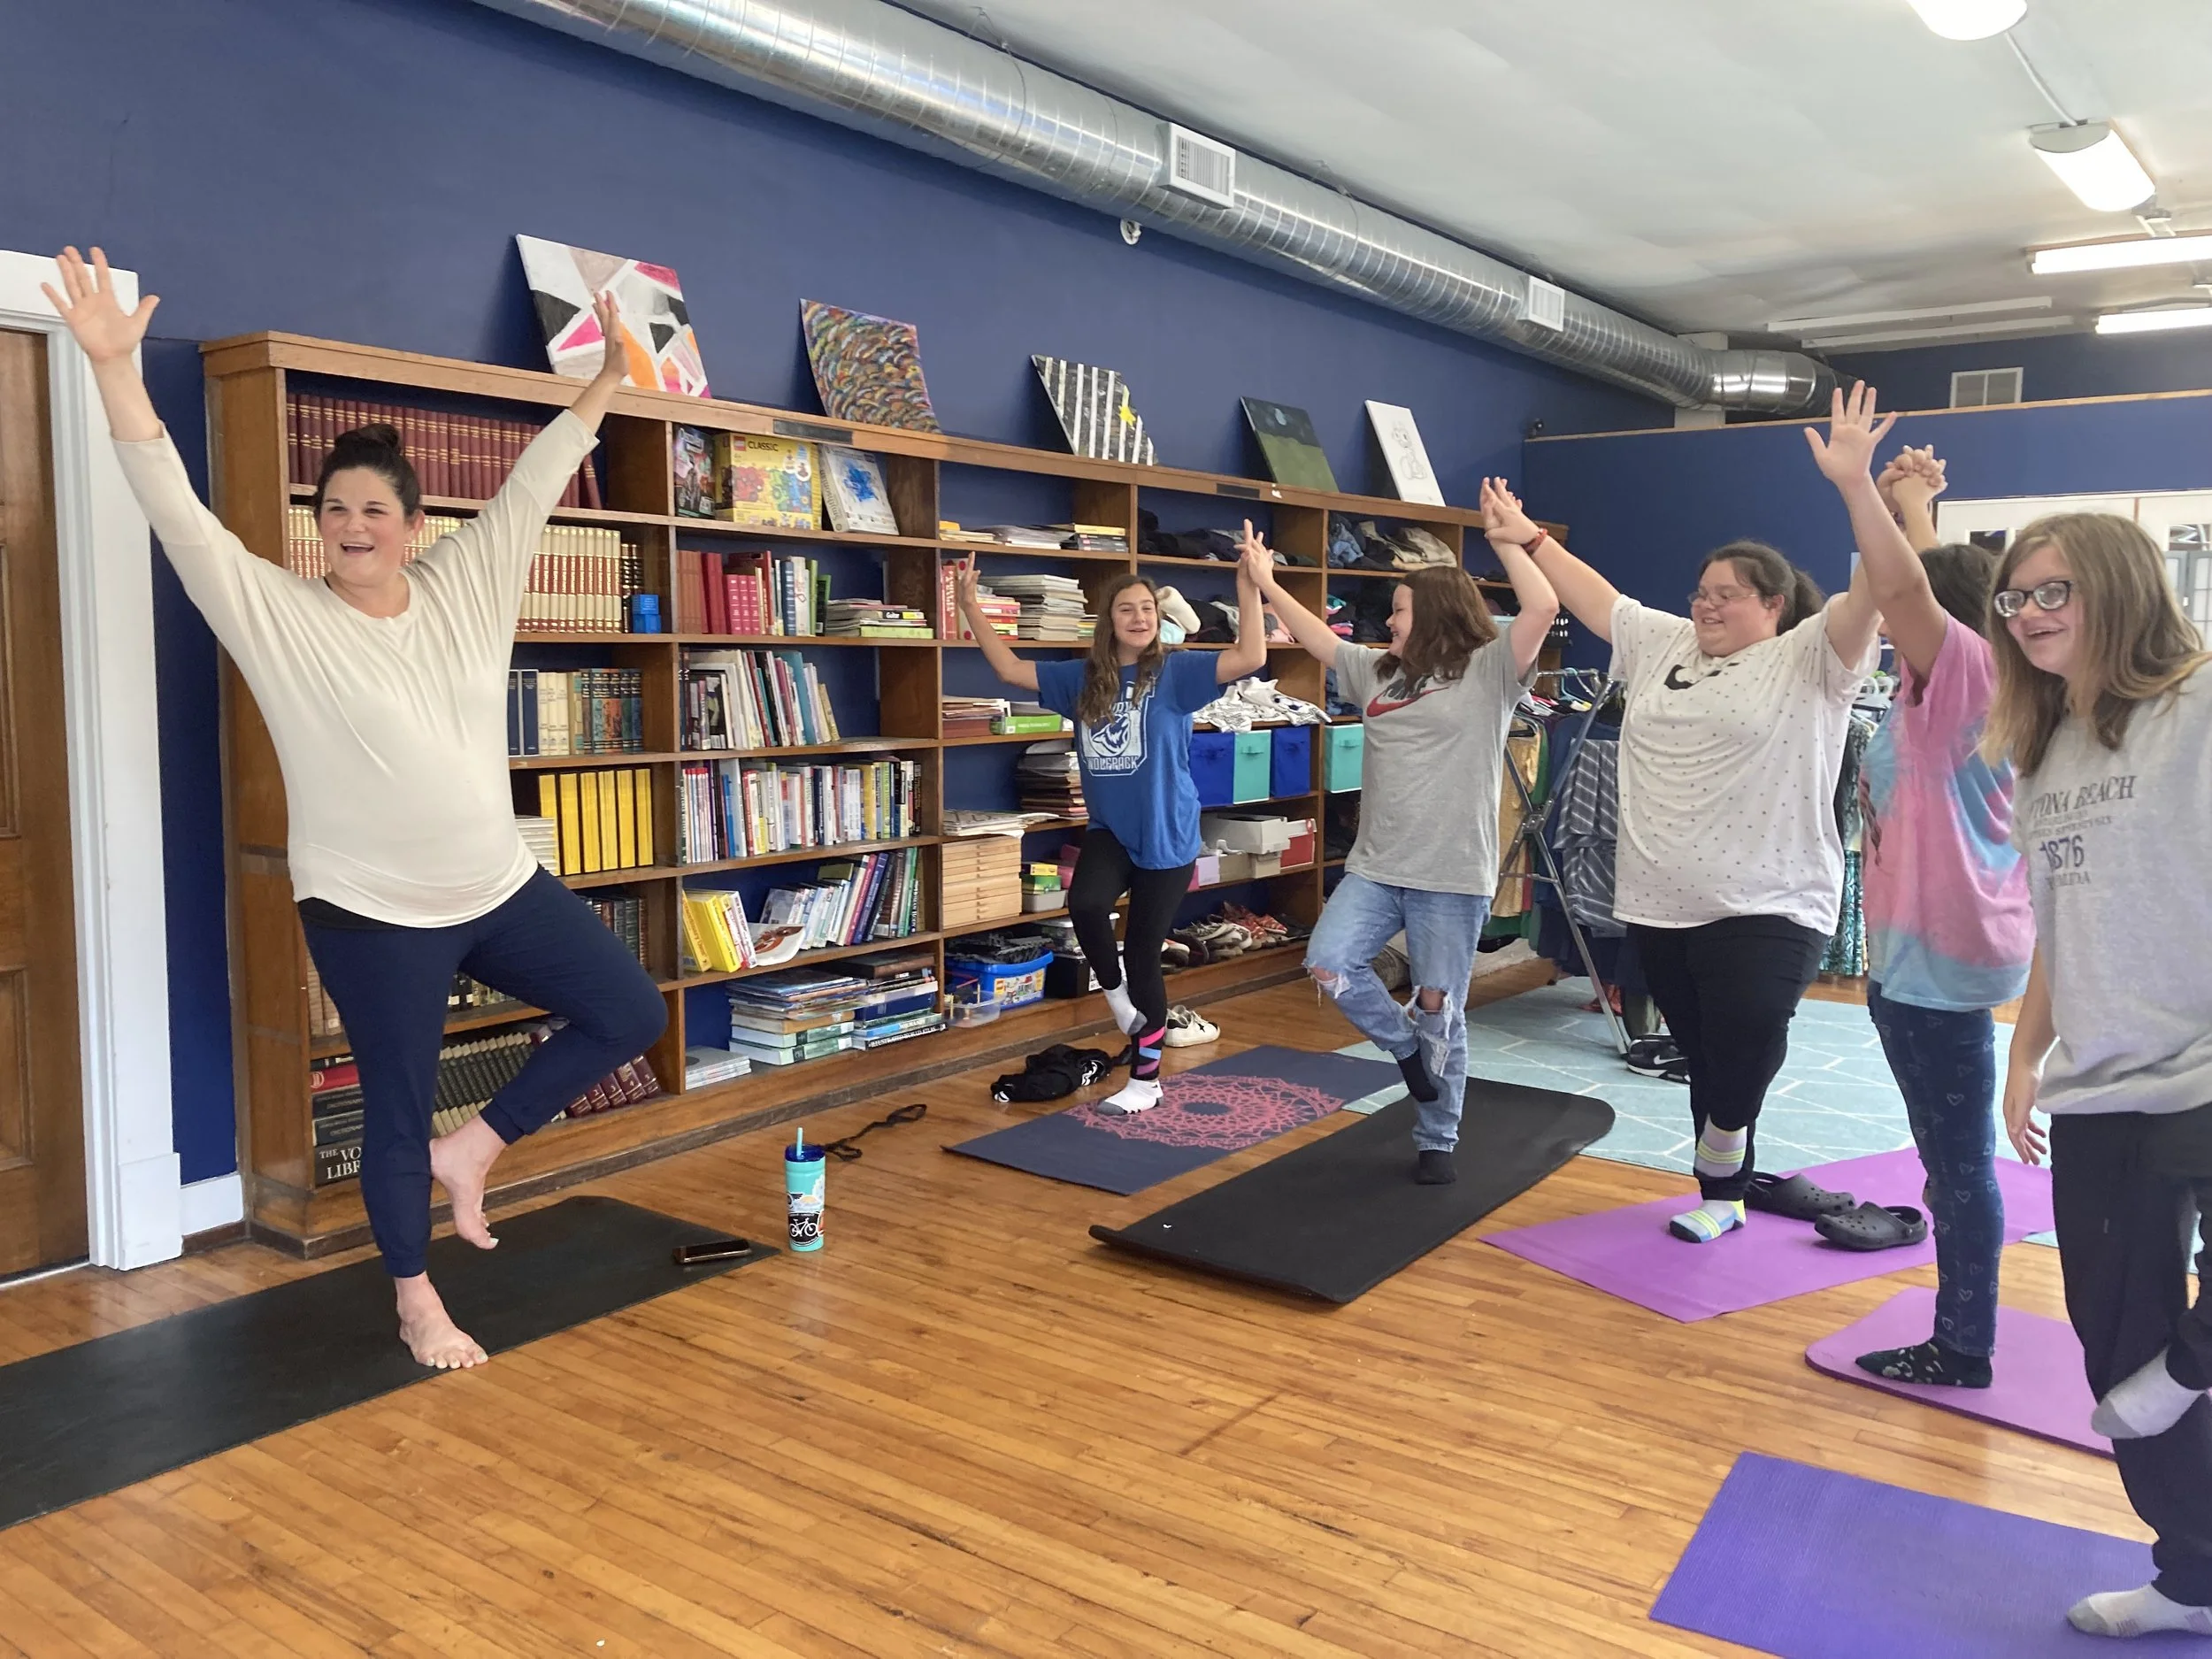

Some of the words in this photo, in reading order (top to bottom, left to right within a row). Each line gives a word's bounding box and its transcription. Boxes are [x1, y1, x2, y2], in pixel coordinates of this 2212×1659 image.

[747, 441, 779, 452] CLASSIC
[1087, 755, 1140, 771] WOLFPACK
[2073, 775, 2138, 810] BEACH
[2039, 834, 2085, 870] 1876
[319, 1148, 338, 1159] THE
